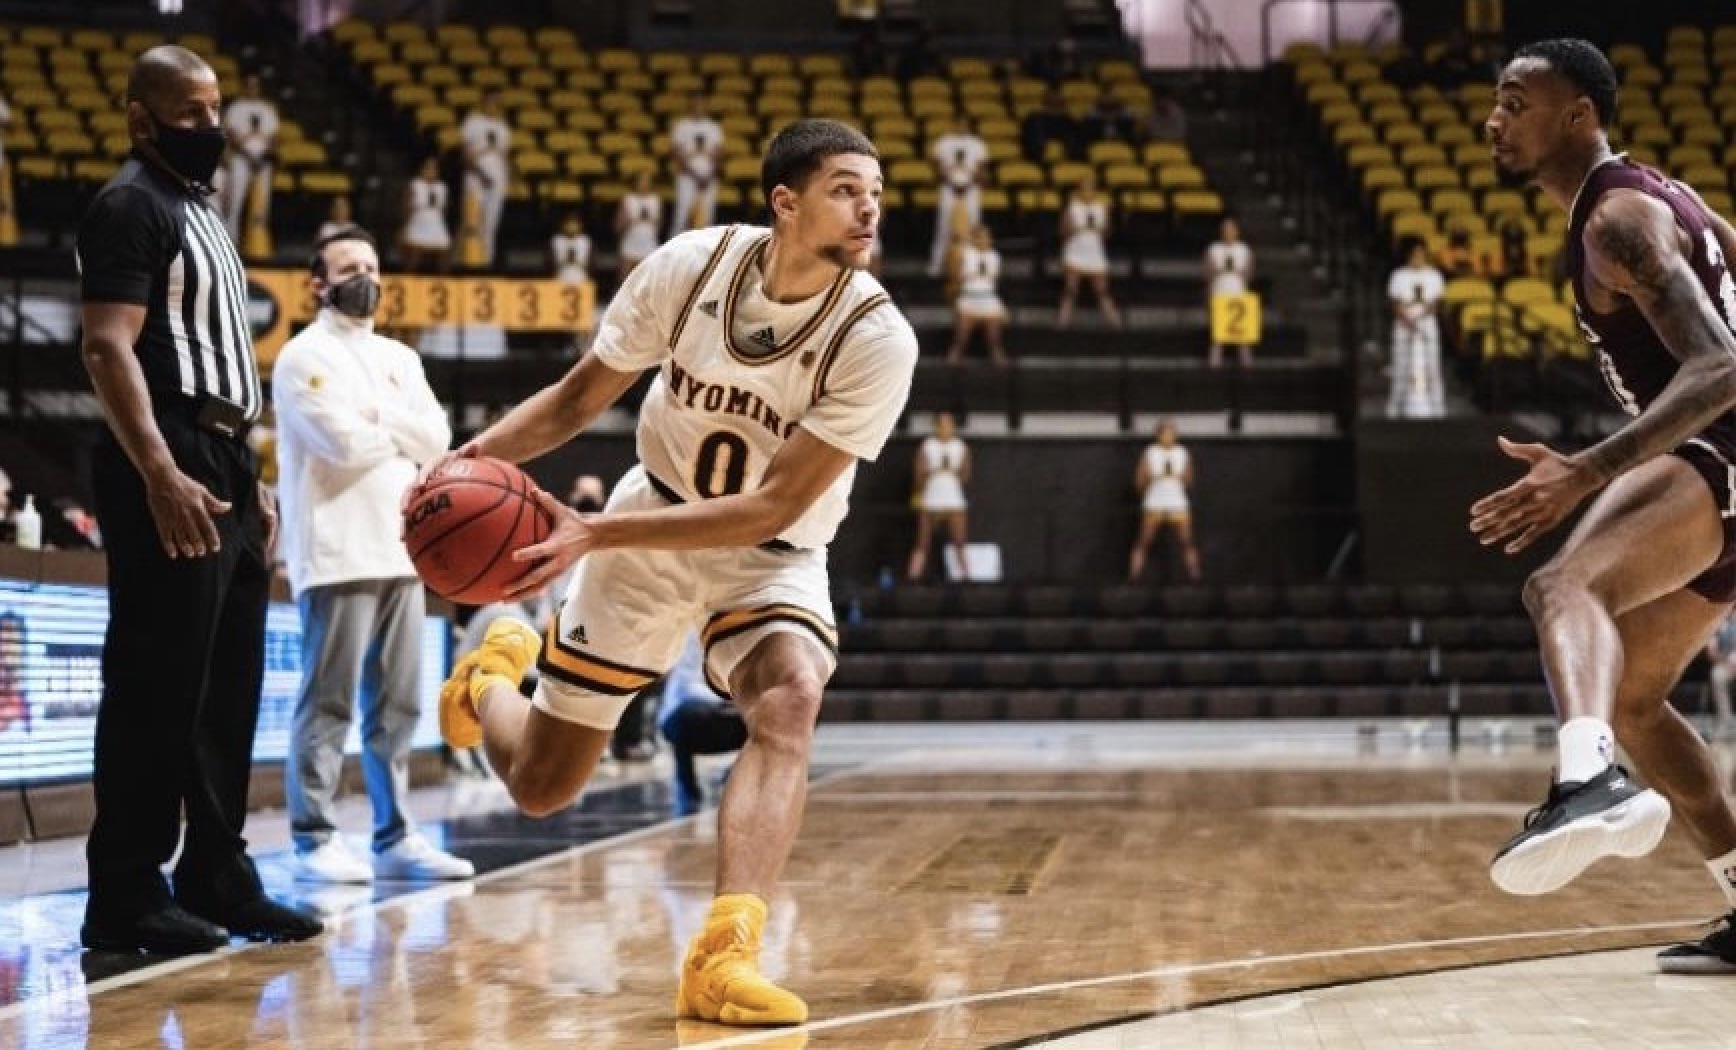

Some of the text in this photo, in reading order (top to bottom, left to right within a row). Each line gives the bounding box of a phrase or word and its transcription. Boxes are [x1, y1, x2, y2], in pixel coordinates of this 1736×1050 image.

[387, 281, 407, 320] 3
[428, 282, 450, 321] 3
[472, 282, 495, 322] 3
[517, 283, 539, 323] 3
[560, 283, 582, 324] 3
[1225, 299, 1247, 336] 2
[694, 430, 748, 498] 0
